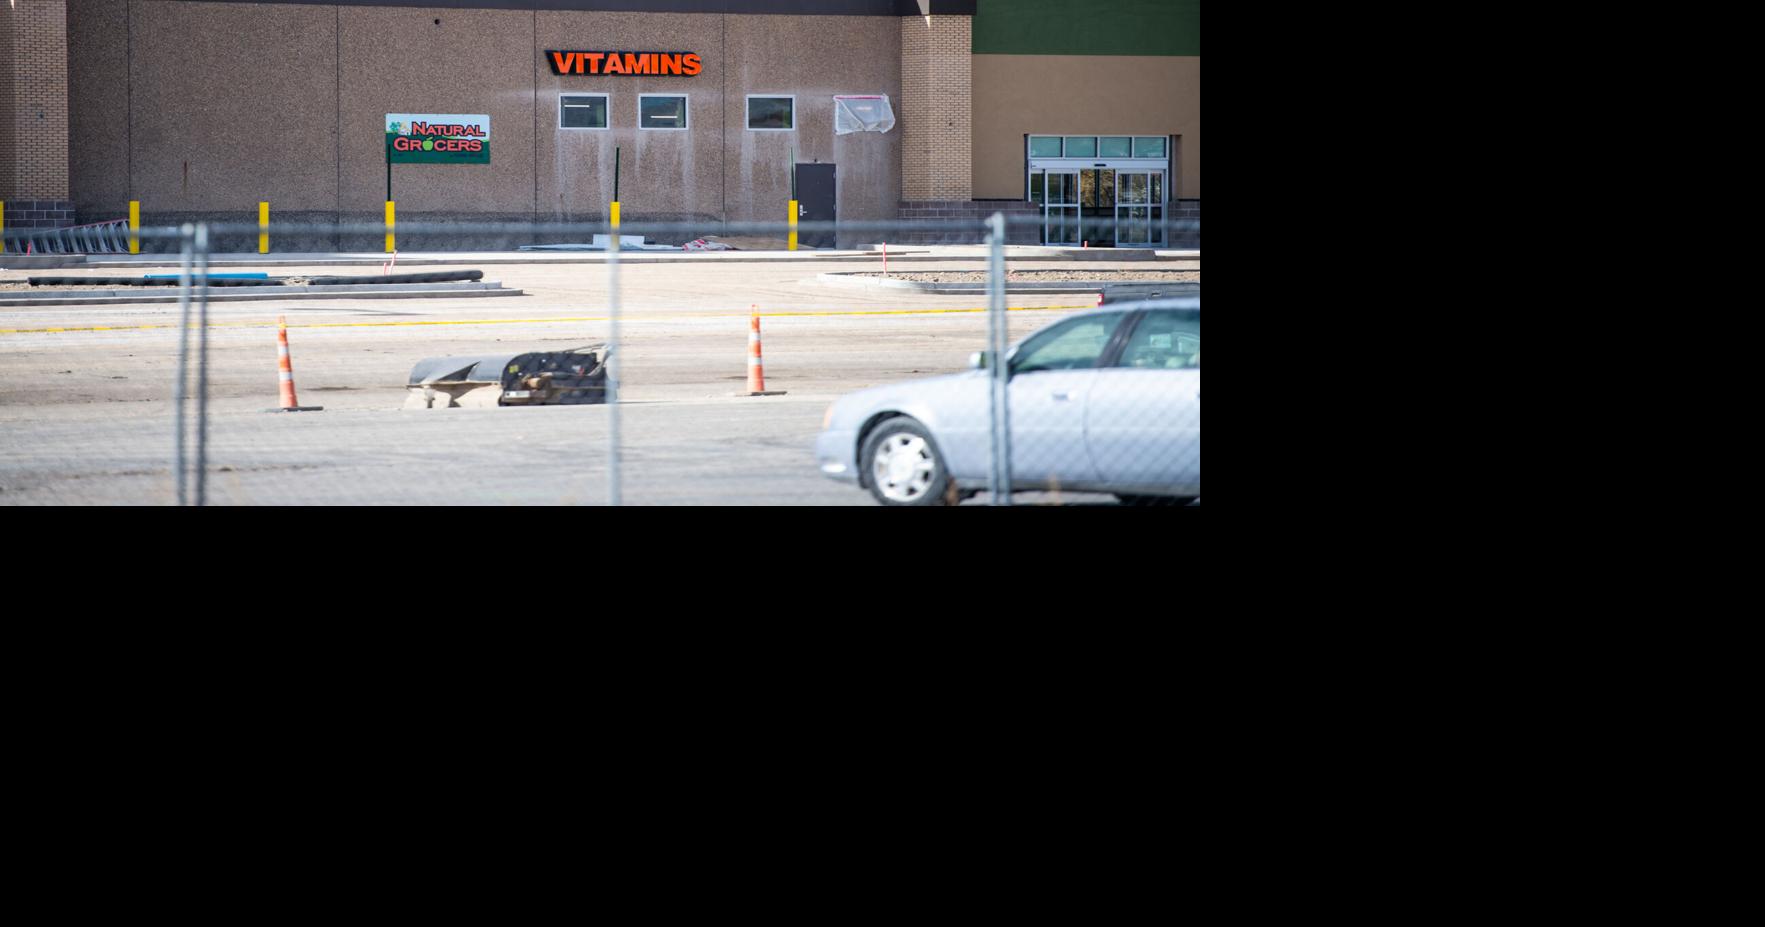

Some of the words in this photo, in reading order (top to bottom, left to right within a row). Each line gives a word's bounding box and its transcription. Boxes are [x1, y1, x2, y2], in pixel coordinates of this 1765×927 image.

[552, 51, 703, 77] VITAMINS
[412, 121, 486, 137] NATURAL
[393, 136, 483, 152] GROCERS
